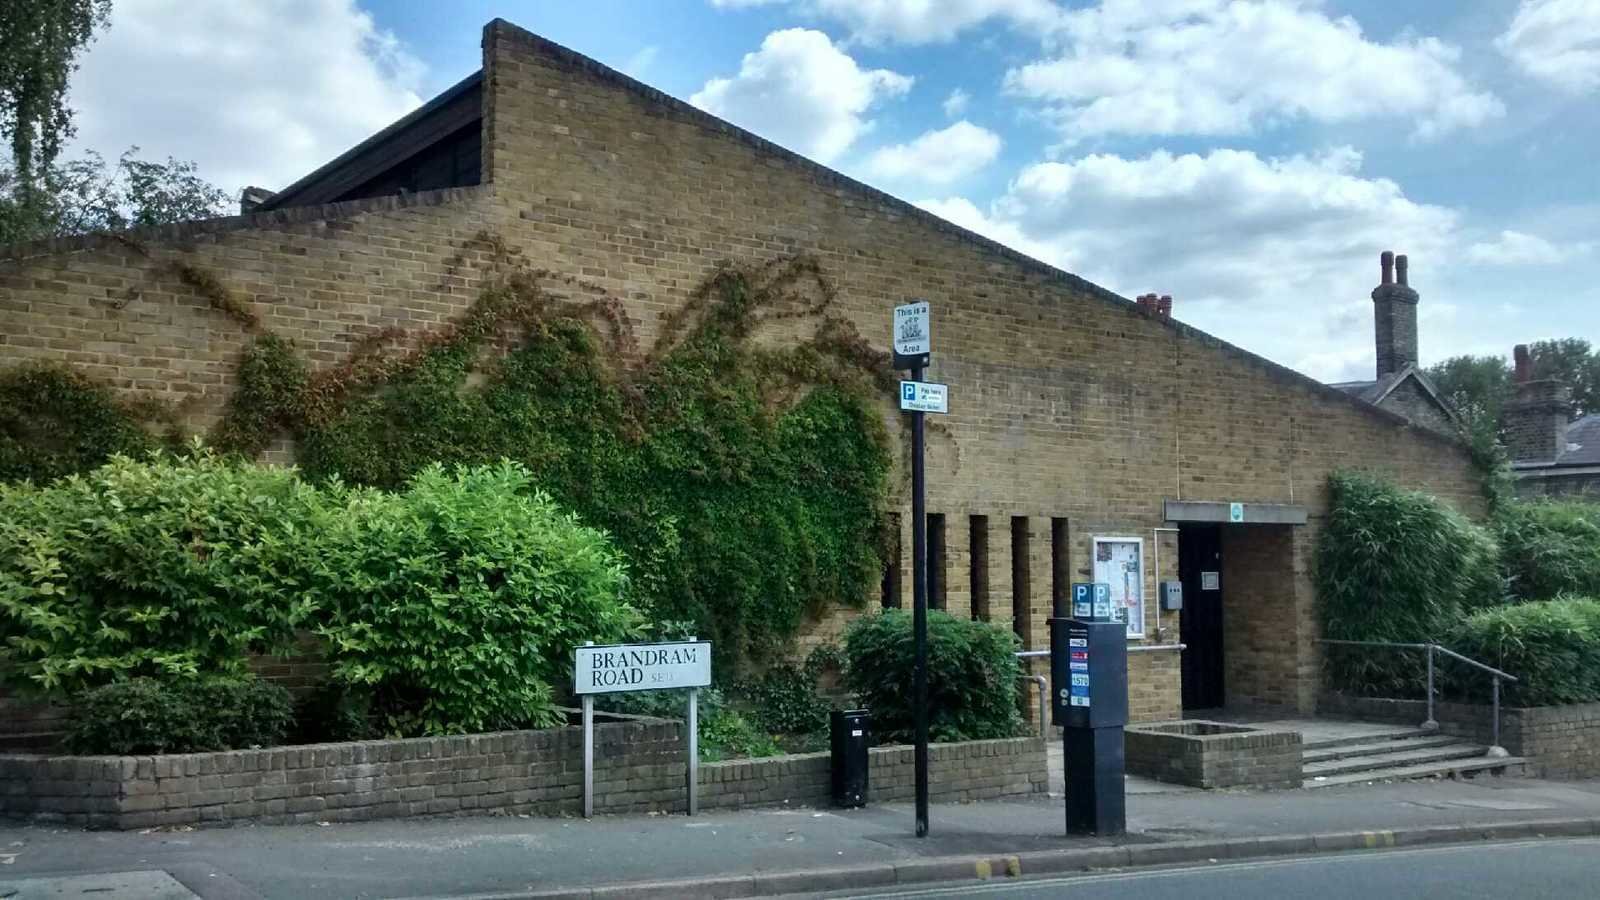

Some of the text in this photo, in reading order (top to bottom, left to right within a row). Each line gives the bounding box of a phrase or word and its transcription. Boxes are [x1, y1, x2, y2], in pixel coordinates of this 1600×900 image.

[897, 309, 912, 317] This
[903, 345, 920, 353] Area
[905, 385, 913, 398] P
[1077, 586, 1087, 601] P
[1096, 586, 1106, 602] P
[592, 648, 697, 669] BRANDRAM
[592, 668, 643, 686] ROAD
